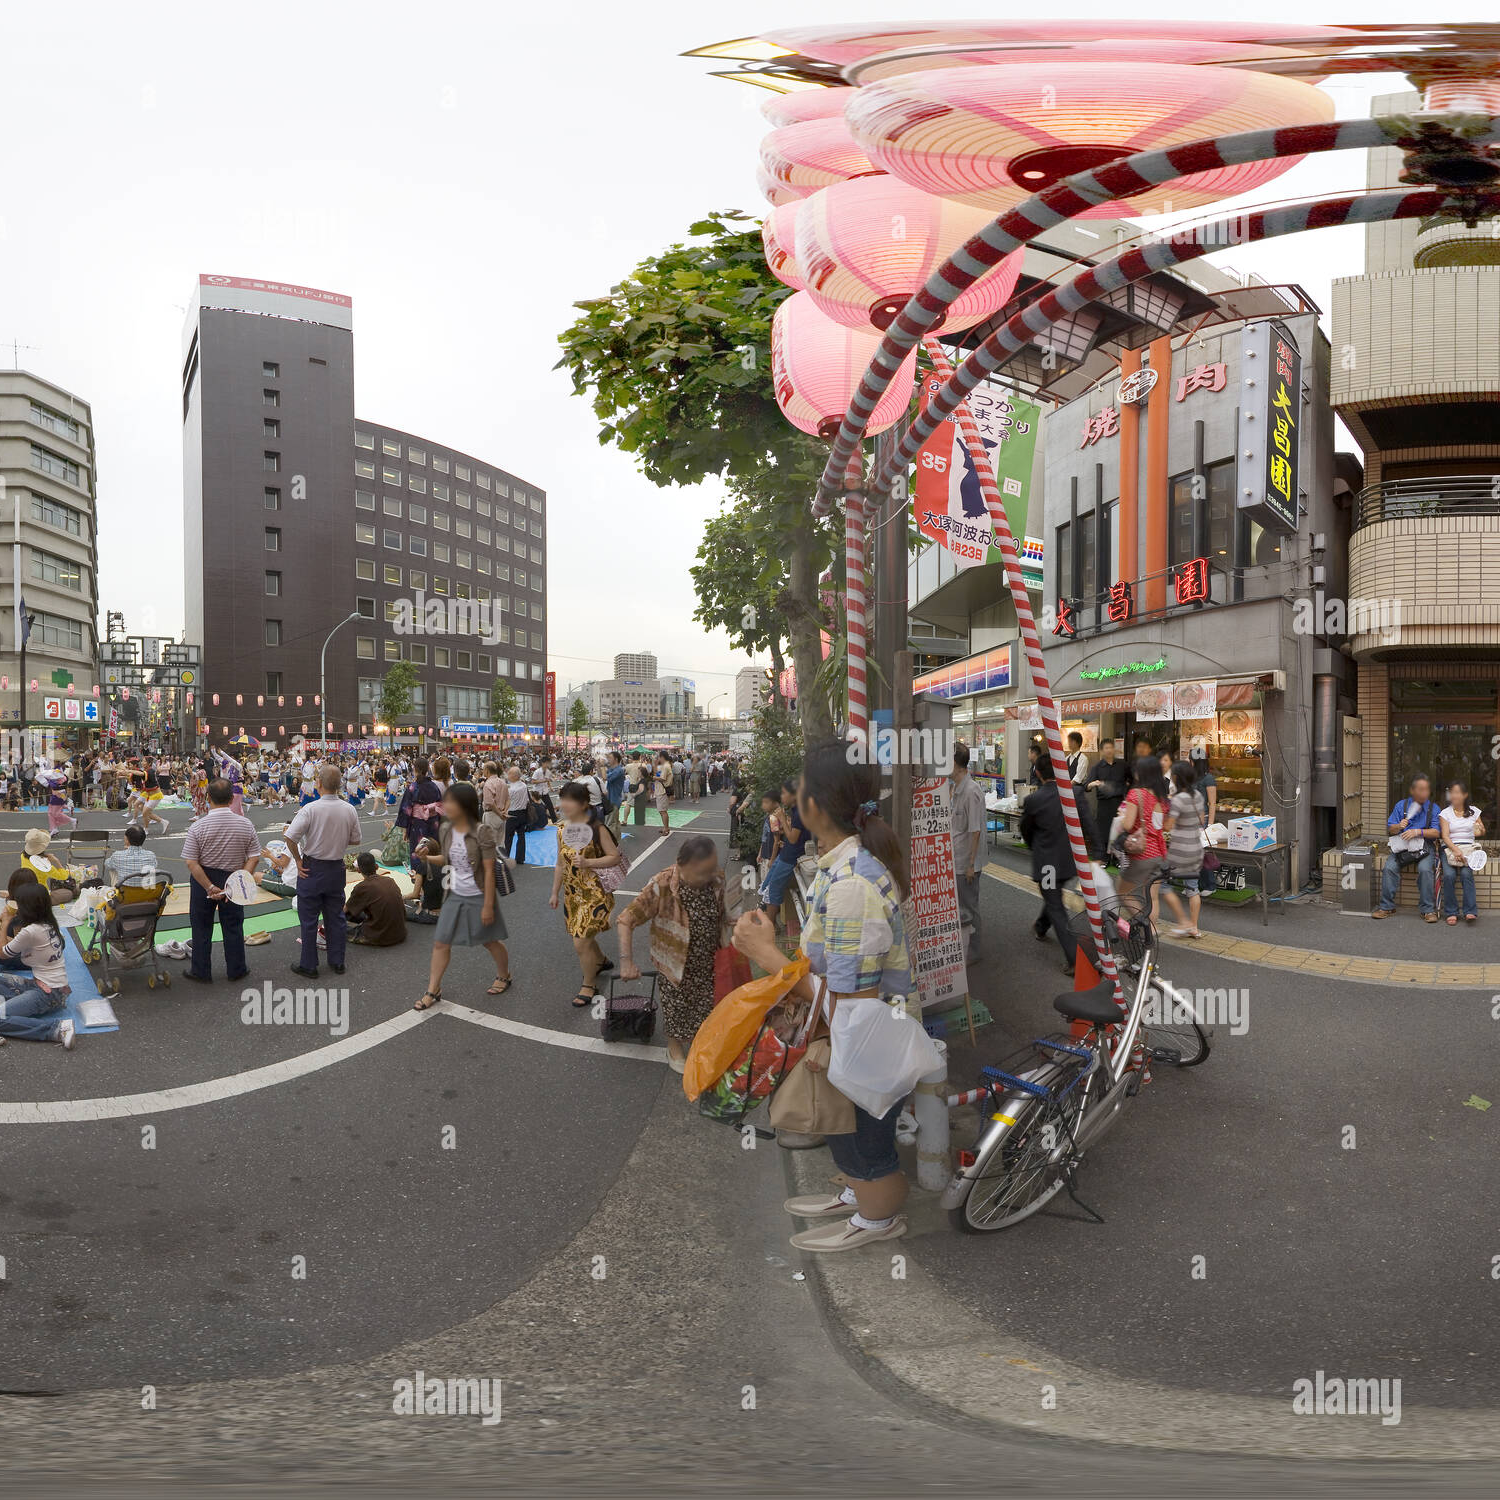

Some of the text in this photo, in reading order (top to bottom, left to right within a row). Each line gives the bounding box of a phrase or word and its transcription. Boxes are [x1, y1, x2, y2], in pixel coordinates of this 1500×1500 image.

[1276, 339, 1293, 386] 焼肉
[922, 451, 947, 473] 35
[1270, 381, 1295, 502] 大昌園
[1052, 557, 1208, 635] 大昌園
